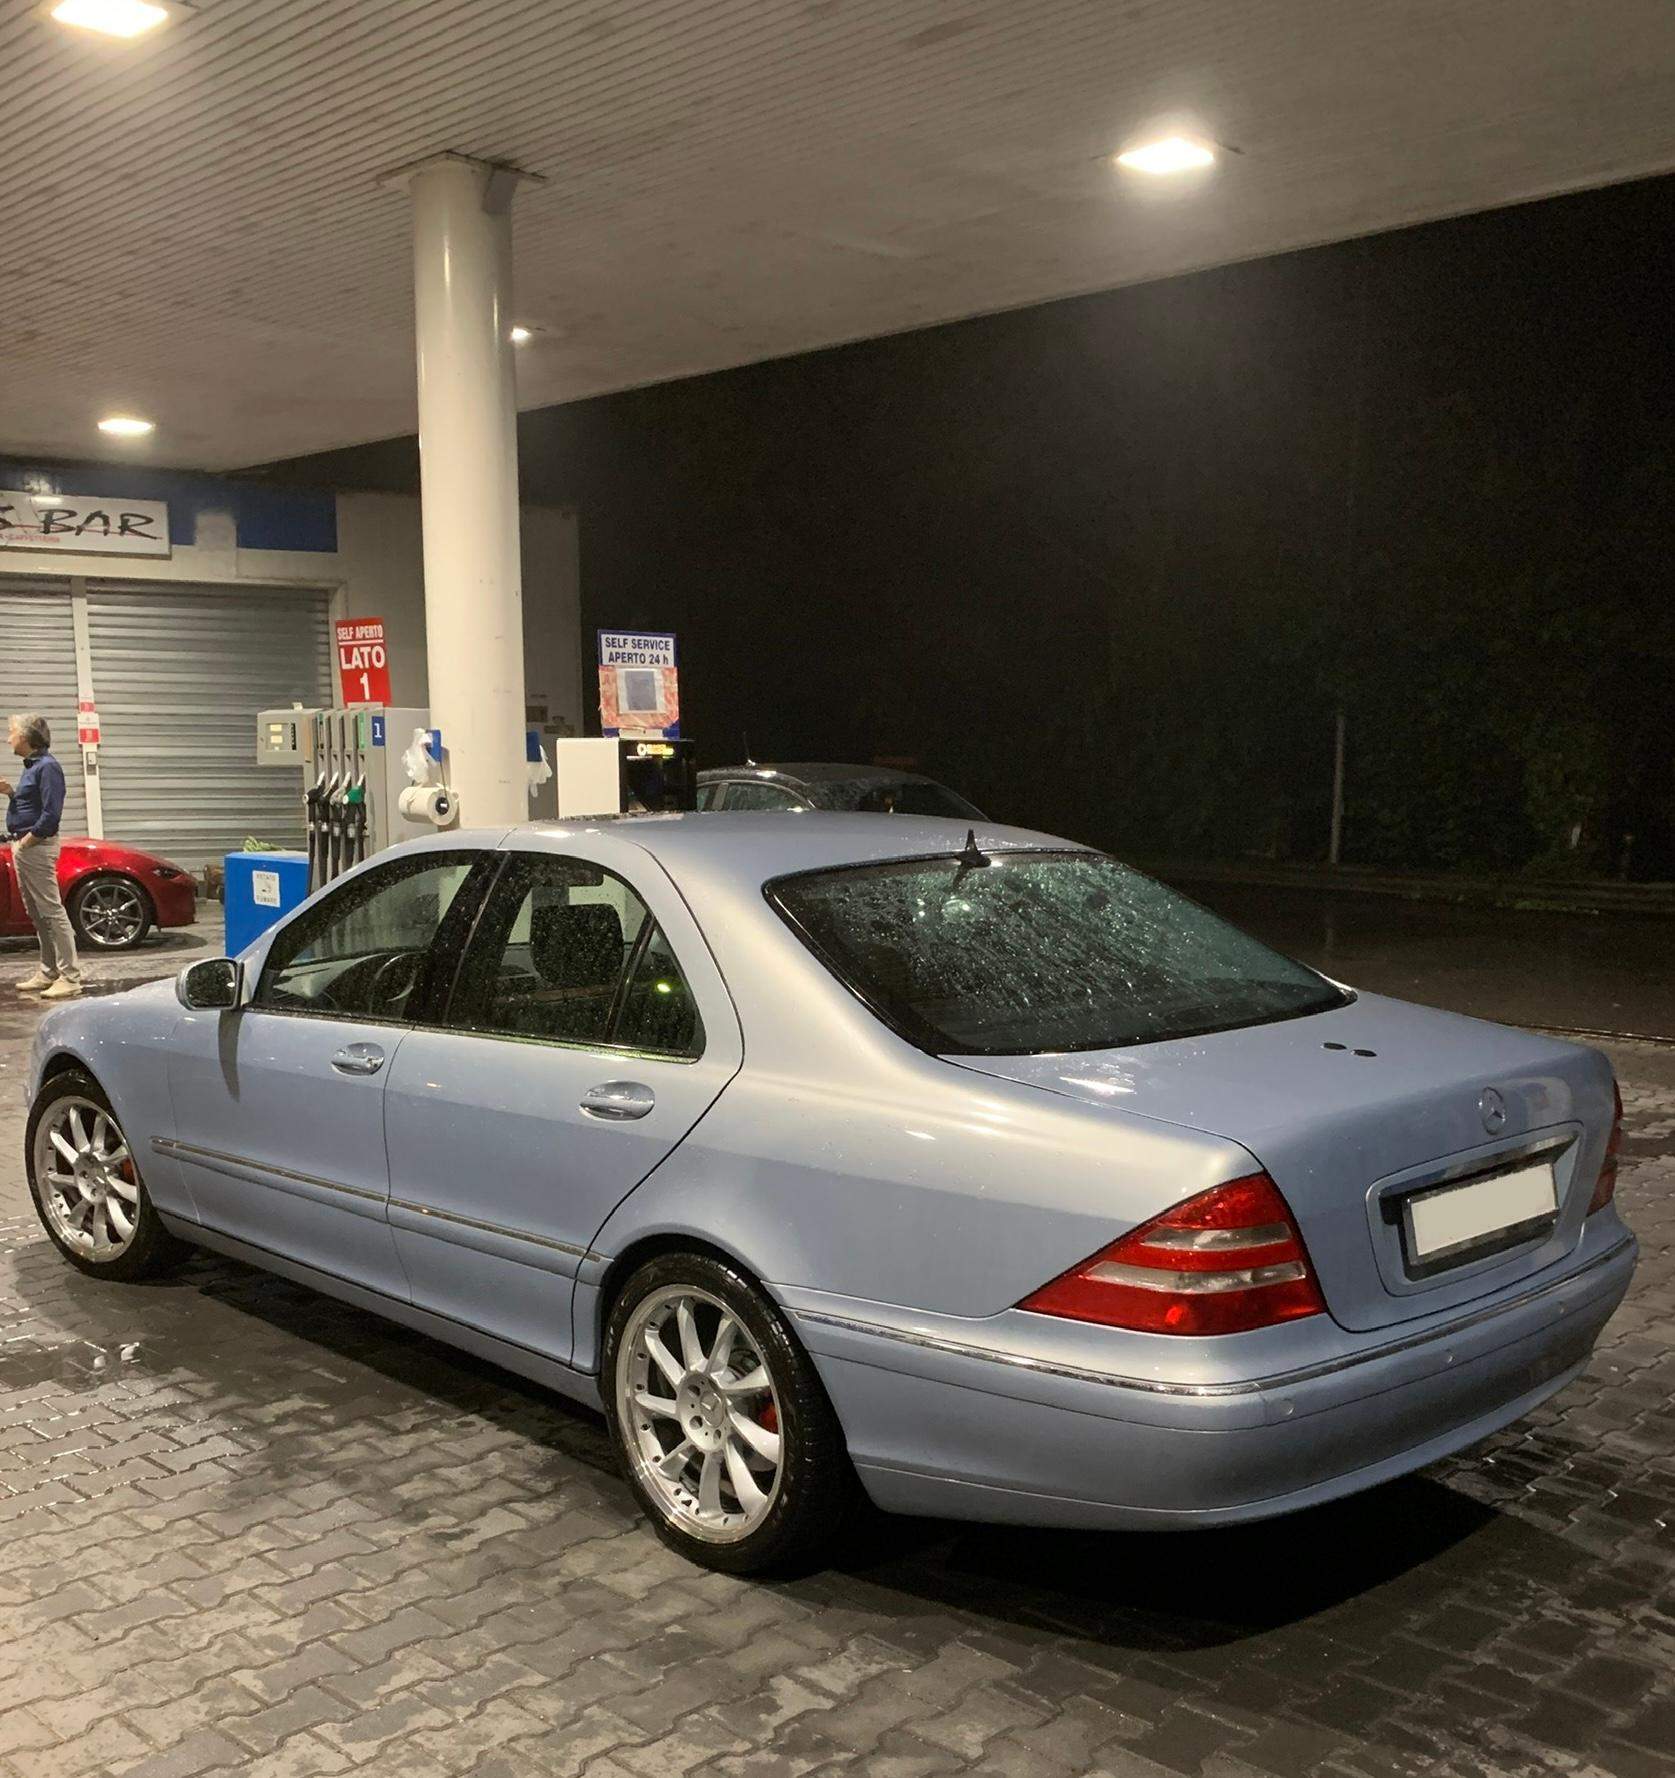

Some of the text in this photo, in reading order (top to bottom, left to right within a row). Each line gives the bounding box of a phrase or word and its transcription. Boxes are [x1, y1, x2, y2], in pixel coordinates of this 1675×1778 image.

[38, 508, 161, 540] BAR
[337, 625, 383, 640] SELF APERTO
[605, 637, 670, 651] SELF SERVICE
[340, 645, 385, 669] LATO
[608, 652, 669, 665] APERTO 24 h
[360, 672, 370, 700] 1
[374, 722, 382, 738] 1
